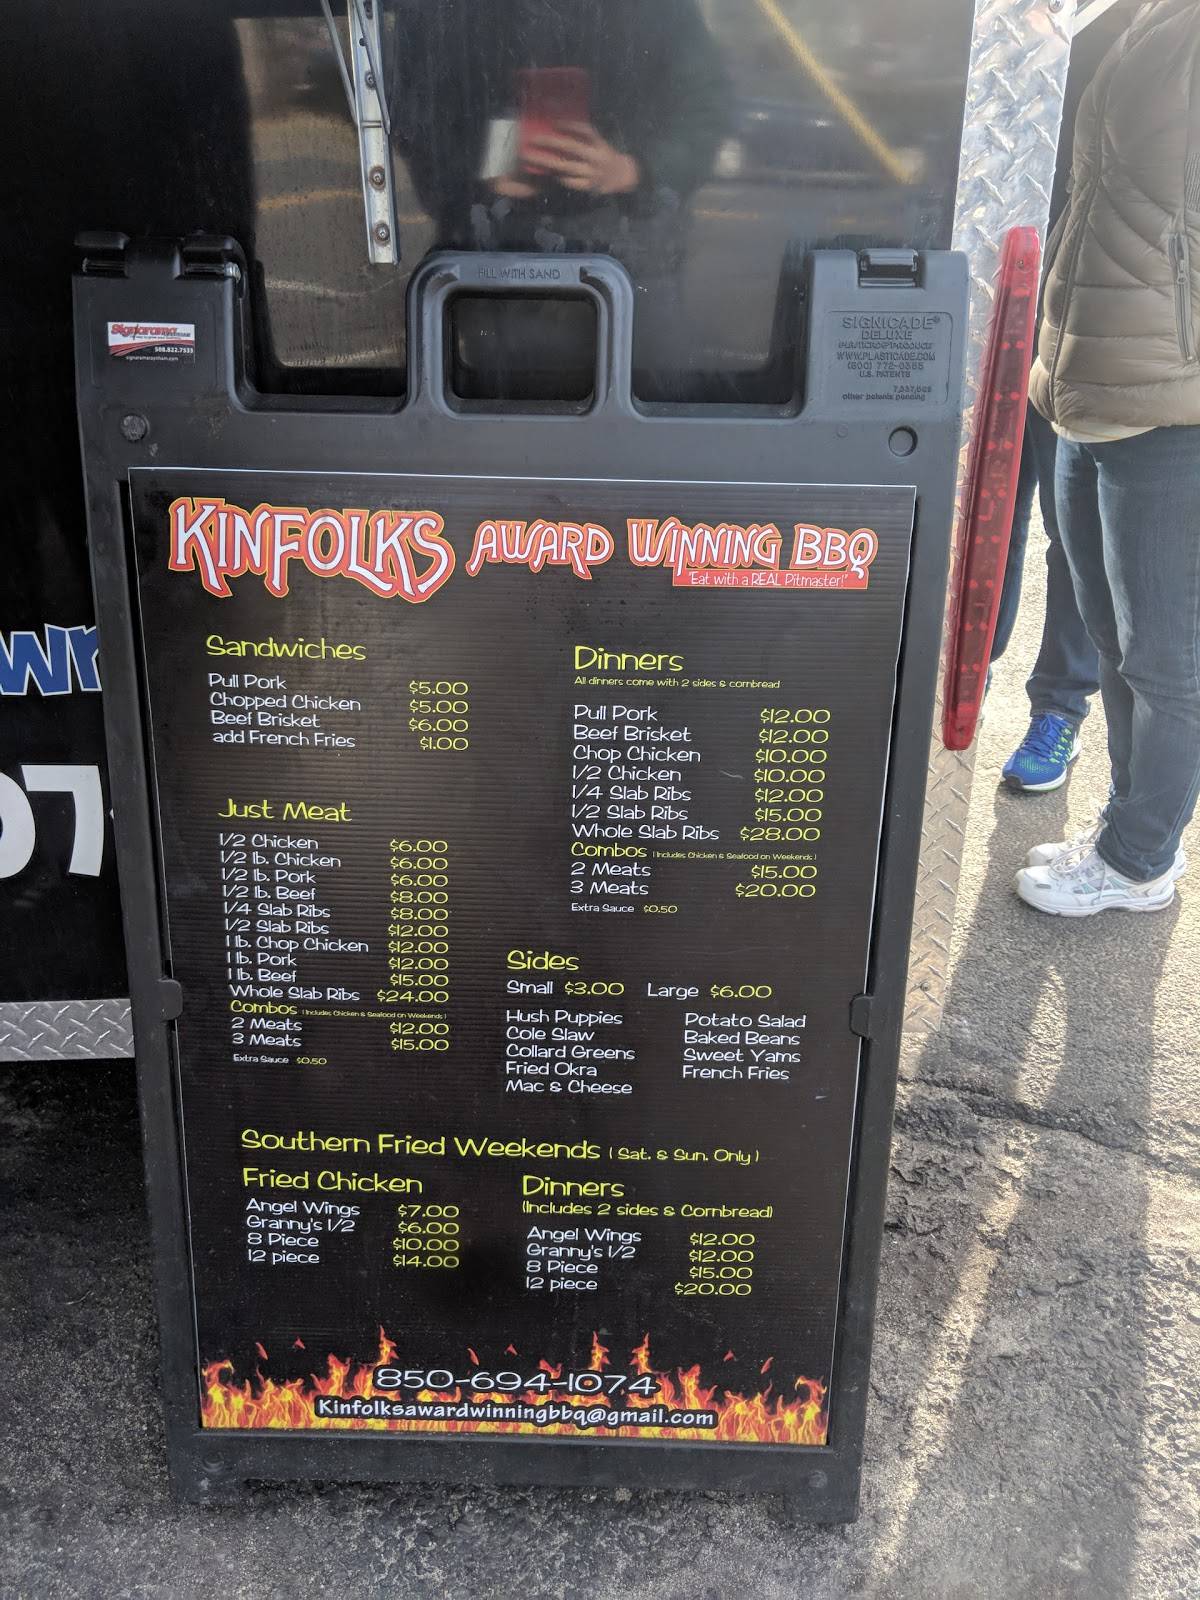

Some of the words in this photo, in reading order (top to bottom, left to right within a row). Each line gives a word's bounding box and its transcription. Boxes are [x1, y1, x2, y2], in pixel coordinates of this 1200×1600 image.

[478, 268, 496, 278] FILL
[500, 269, 525, 279] WITH
[529, 269, 560, 279] SAND
[168, 497, 455, 603] KINFOLKS
[466, 519, 614, 579] AWARD
[627, 516, 782, 576] WINNING
[789, 523, 878, 578] BBQ
[714, 573, 738, 585] with
[742, 576, 748, 585] a
[751, 573, 780, 586] REAL
[206, 635, 366, 660] Sandwiches
[574, 645, 684, 672] Dinners
[208, 673, 239, 688] Pull
[244, 674, 287, 689] Pork
[409, 680, 468, 695] $5.00
[574, 676, 586, 684] All
[589, 677, 623, 686] dinners
[626, 678, 654, 686] come
[657, 678, 678, 686] with
[681, 679, 689, 687] 2
[693, 679, 716, 687] sides
[729, 680, 780, 689] cornbread
[209, 692, 287, 710] Chopped
[292, 695, 361, 711] Chicken
[409, 700, 468, 714] $5.00
[211, 710, 252, 725] Beef
[257, 712, 320, 728] Brisket
[408, 718, 468, 732] $6.00
[574, 705, 606, 720] Pull
[613, 705, 658, 721] Pork
[760, 708, 831, 723] $12.00
[212, 730, 244, 743] add
[250, 730, 309, 746] French
[314, 732, 355, 747] Fries
[420, 737, 468, 750] $1.00
[574, 724, 618, 740] Beef
[625, 726, 691, 742] Brisket
[759, 729, 829, 743] $12.00
[572, 785, 603, 799] 1/4
[610, 786, 648, 800] Slab
[654, 786, 691, 801] Ribs
[755, 788, 824, 803] $12.00
[218, 799, 274, 819] Just
[283, 802, 352, 822] Meat
[572, 823, 632, 838] Whole
[638, 824, 677, 839] Slab
[682, 826, 719, 840] Ribs
[740, 826, 821, 841] $28.00
[219, 833, 246, 847] 1/2
[252, 834, 318, 849] Chicken
[390, 839, 448, 853] $6.00
[571, 842, 647, 857] Combos
[220, 850, 246, 864] 1/2
[253, 852, 269, 865] lb.
[275, 852, 341, 867] Chicken
[390, 857, 448, 870] $6.00
[571, 862, 585, 875] 2
[592, 862, 651, 876] Meats
[751, 864, 817, 879] $15.00
[570, 881, 583, 894] 3
[590, 881, 648, 895] Meats
[736, 883, 816, 898] $20.00
[571, 903, 599, 912] Extra
[602, 904, 634, 913] Sauce
[644, 905, 677, 913] $0.50
[235, 936, 251, 948] lb.
[257, 936, 299, 951] Chop
[304, 938, 368, 952] Chicken
[388, 942, 448, 954] $12.00
[506, 950, 579, 971] Sides
[229, 985, 283, 998] Whole
[288, 987, 322, 999] Slab
[327, 988, 360, 1001] Ribs
[377, 990, 448, 1003] $24.00
[506, 980, 553, 995] Small
[565, 981, 624, 996] $3.00
[647, 983, 699, 999] Large
[710, 985, 772, 999] $6.00
[506, 1010, 549, 1023] Hush
[555, 1010, 623, 1026] Puppies
[685, 1013, 752, 1028] Potato
[757, 1014, 806, 1028] Salad
[506, 1027, 546, 1040] Cole
[552, 1028, 595, 1041] Slaw
[684, 1030, 740, 1045] Baked
[746, 1032, 800, 1046] Beans
[506, 1044, 566, 1058] Collard
[571, 1046, 635, 1060] Greens
[683, 1048, 744, 1062] Sweet
[750, 1049, 801, 1063] Yams
[506, 1062, 549, 1075] Fried
[555, 1063, 597, 1077] Okra
[683, 1065, 742, 1080] French
[748, 1067, 789, 1080] Fries
[505, 1080, 544, 1092] Mac
[550, 1082, 562, 1093] &
[568, 1081, 632, 1094] Cheese
[241, 1129, 370, 1152] Southern
[378, 1134, 445, 1155] Fried
[454, 1138, 600, 1160] Weekends
[656, 1150, 668, 1159] &
[674, 1149, 708, 1161] Sun.
[243, 1168, 309, 1190] Fried
[317, 1171, 422, 1194] Chicken
[522, 1175, 625, 1197] Dinners
[246, 1198, 297, 1214] Angel
[302, 1201, 360, 1217] Wings
[398, 1205, 459, 1218] $7.00
[598, 1203, 611, 1215] 2
[617, 1204, 658, 1216] sides
[663, 1206, 675, 1216] &
[247, 1233, 262, 1244] 8
[269, 1233, 319, 1247] Piece
[393, 1238, 459, 1251] $10.00
[527, 1226, 579, 1243] Angel
[584, 1228, 641, 1245] Wings
[690, 1233, 755, 1246] $12.00
[527, 1243, 603, 1261] Granny's
[609, 1246, 635, 1259] 1/2
[689, 1250, 754, 1263] $12.00
[375, 1369, 658, 1395] 850-694-1074
[318, 1400, 714, 1426] Kinfolksawardwinningbbq@gmail.com
